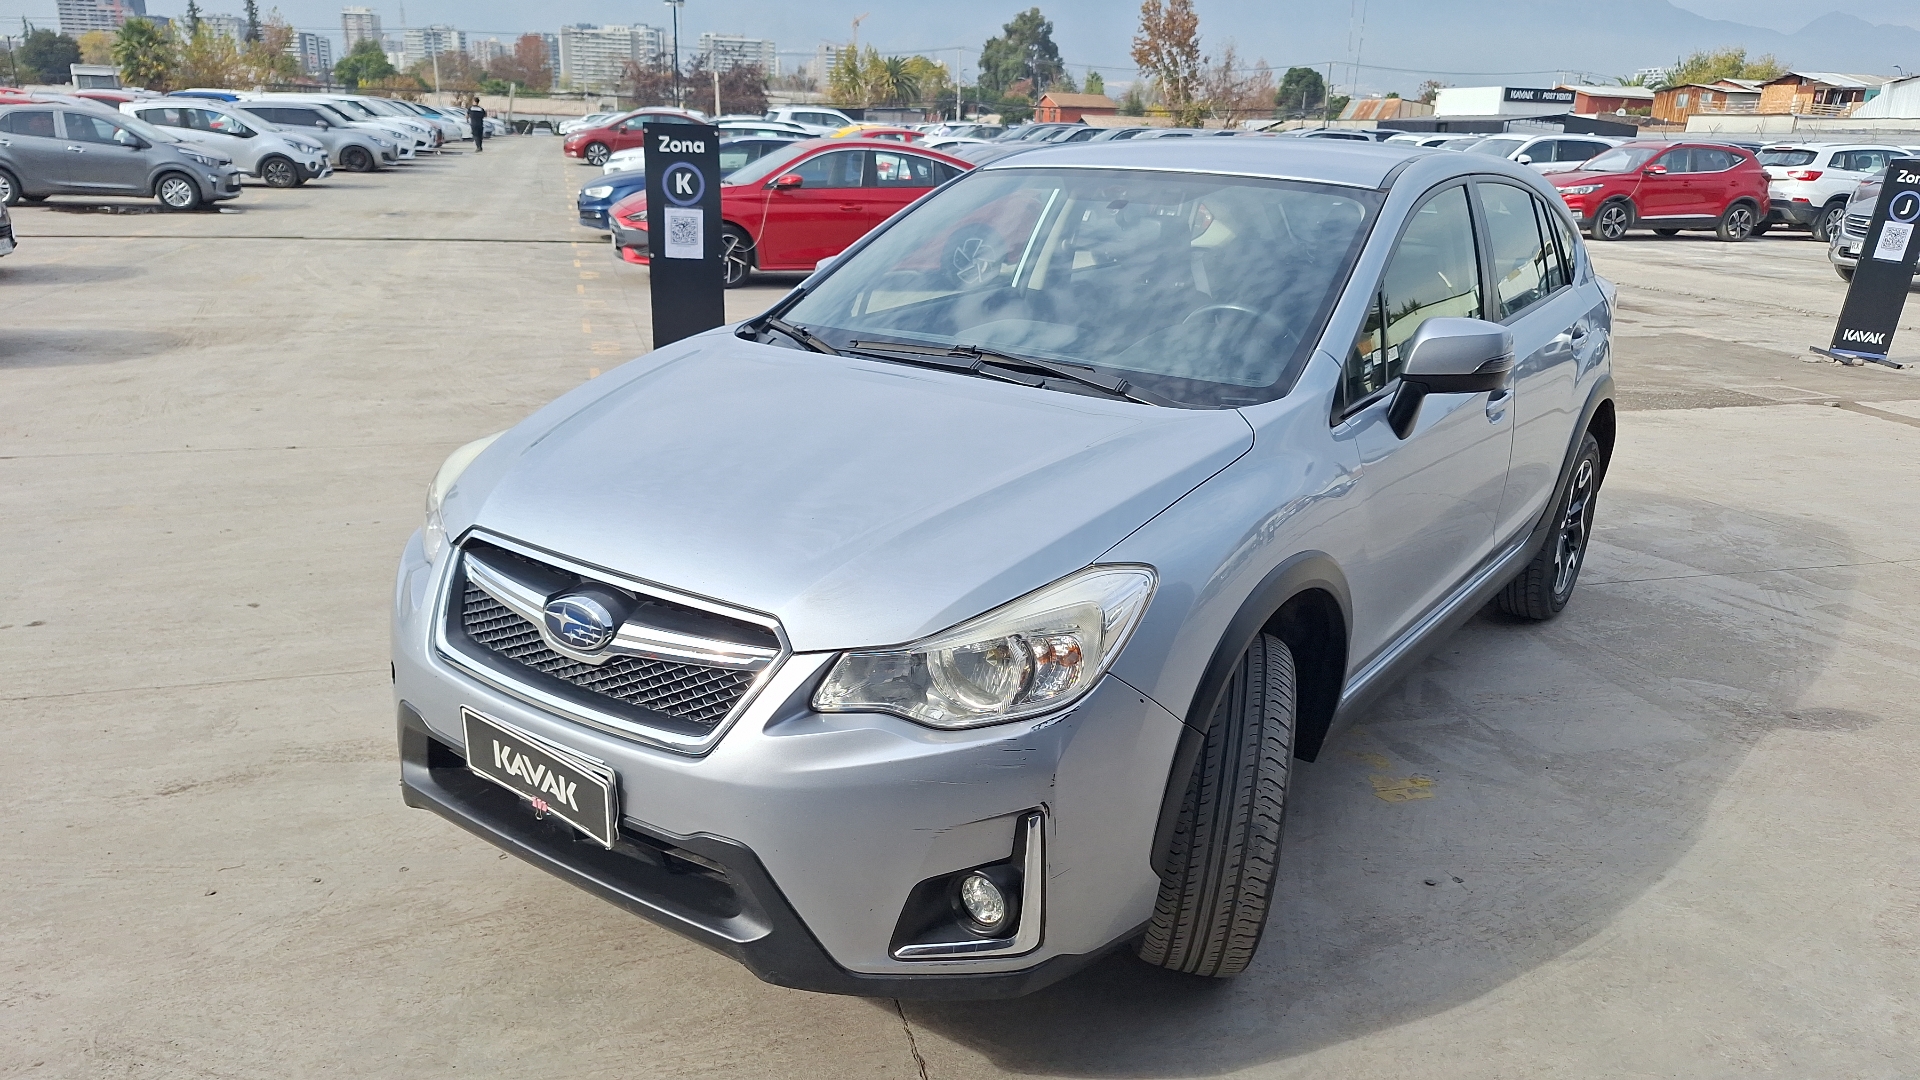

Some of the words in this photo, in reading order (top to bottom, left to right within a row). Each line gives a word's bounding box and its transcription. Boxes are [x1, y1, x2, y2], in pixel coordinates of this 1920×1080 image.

[1510, 90, 1534, 99] KAVAK
[1542, 92, 1556, 100] POST
[1556, 92, 1572, 100] VENTA
[657, 135, 705, 153] Zona
[675, 172, 693, 195] K
[1896, 169, 1920, 184] Zon
[1900, 199, 1913, 215] J
[1842, 328, 1886, 345] KAVAK
[492, 739, 579, 812] KAVAK
